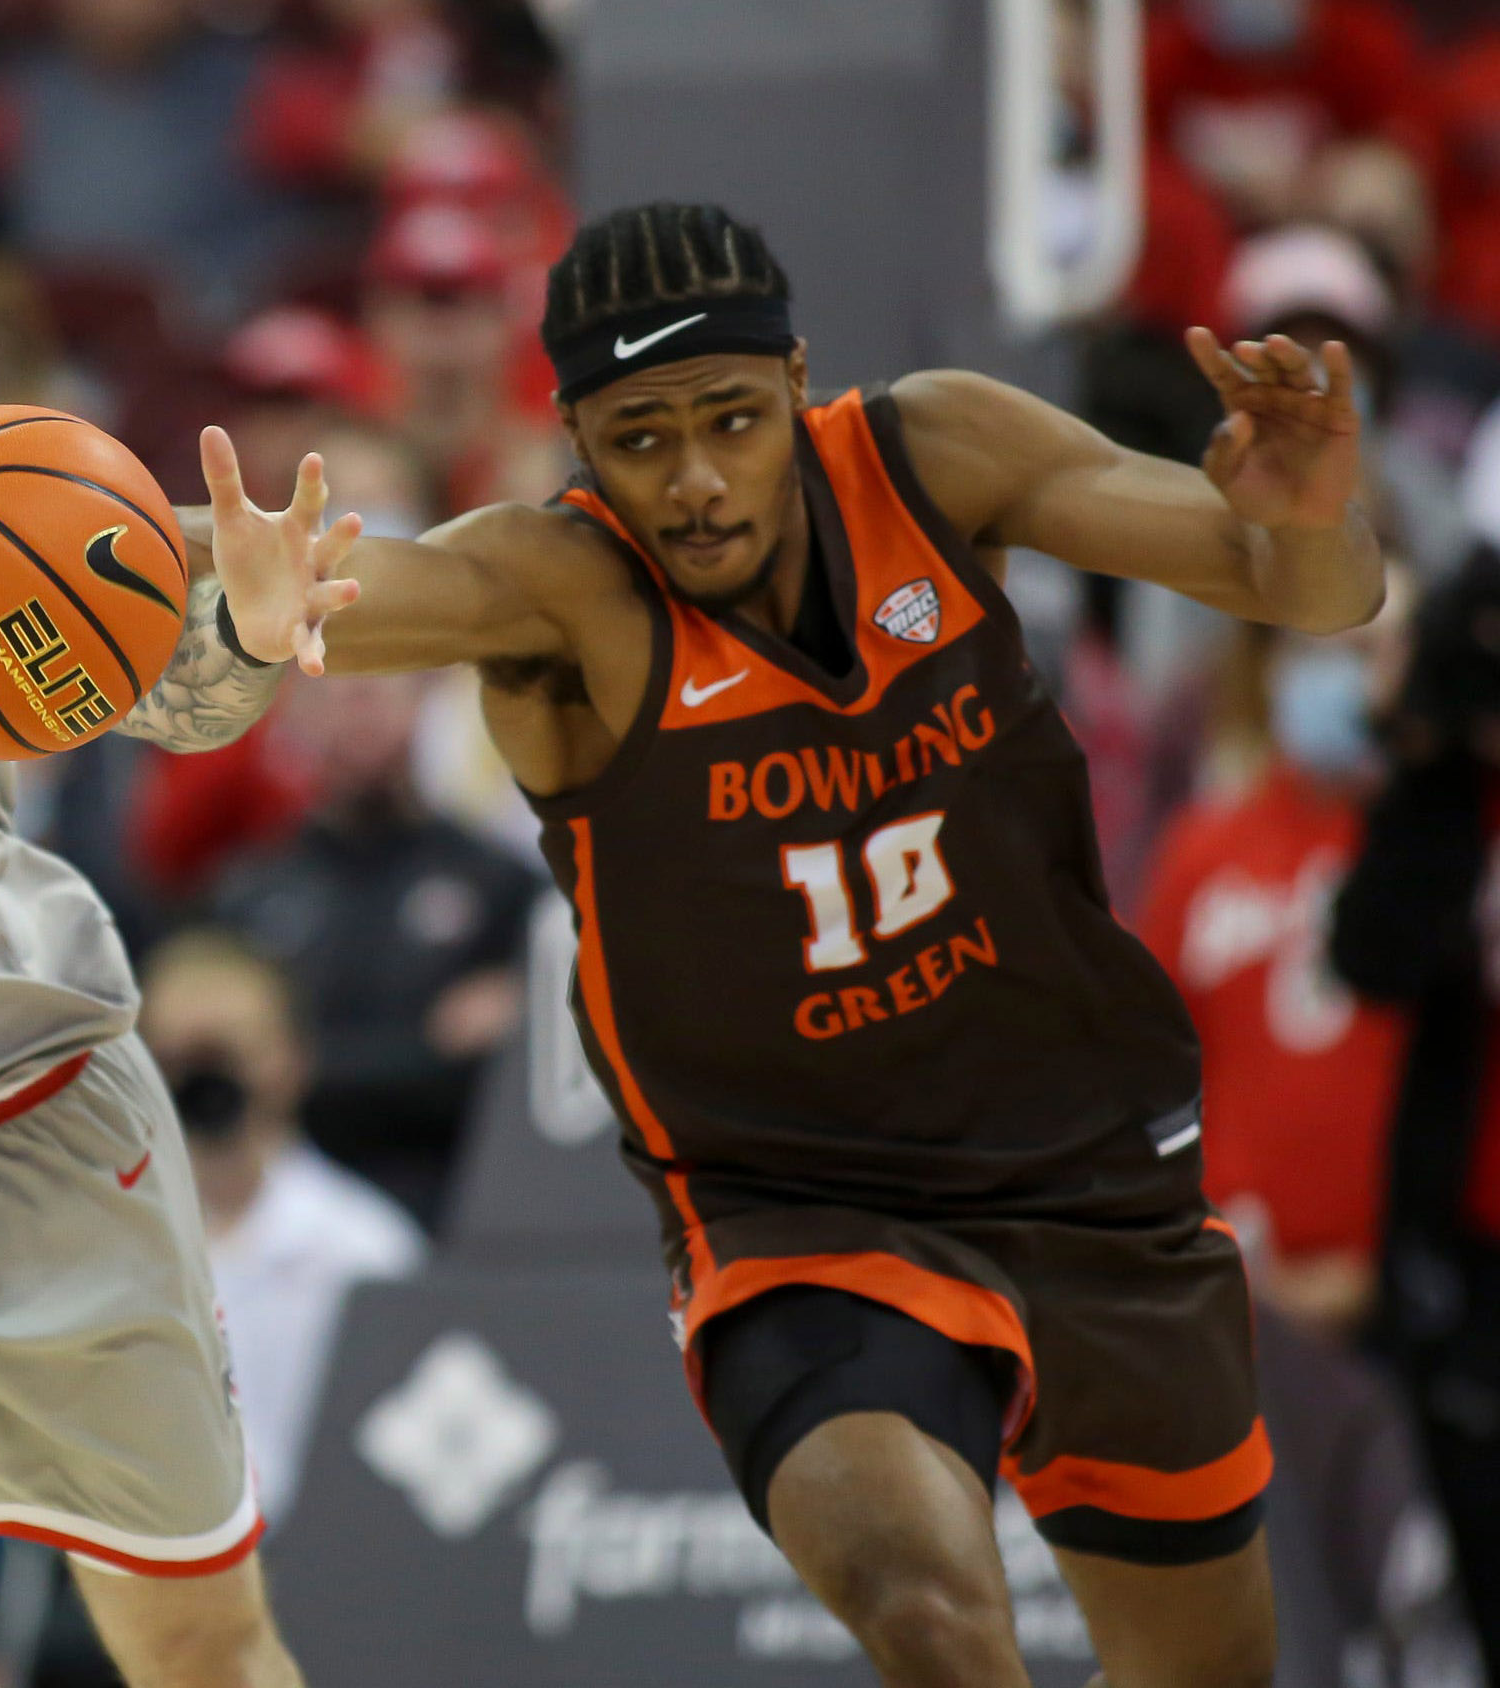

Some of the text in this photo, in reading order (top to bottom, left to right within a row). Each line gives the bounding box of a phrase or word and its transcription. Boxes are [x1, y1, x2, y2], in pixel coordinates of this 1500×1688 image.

[707, 683, 997, 822] BOWLING
[779, 809, 956, 974] 10
[794, 916, 998, 1041] GREEN
